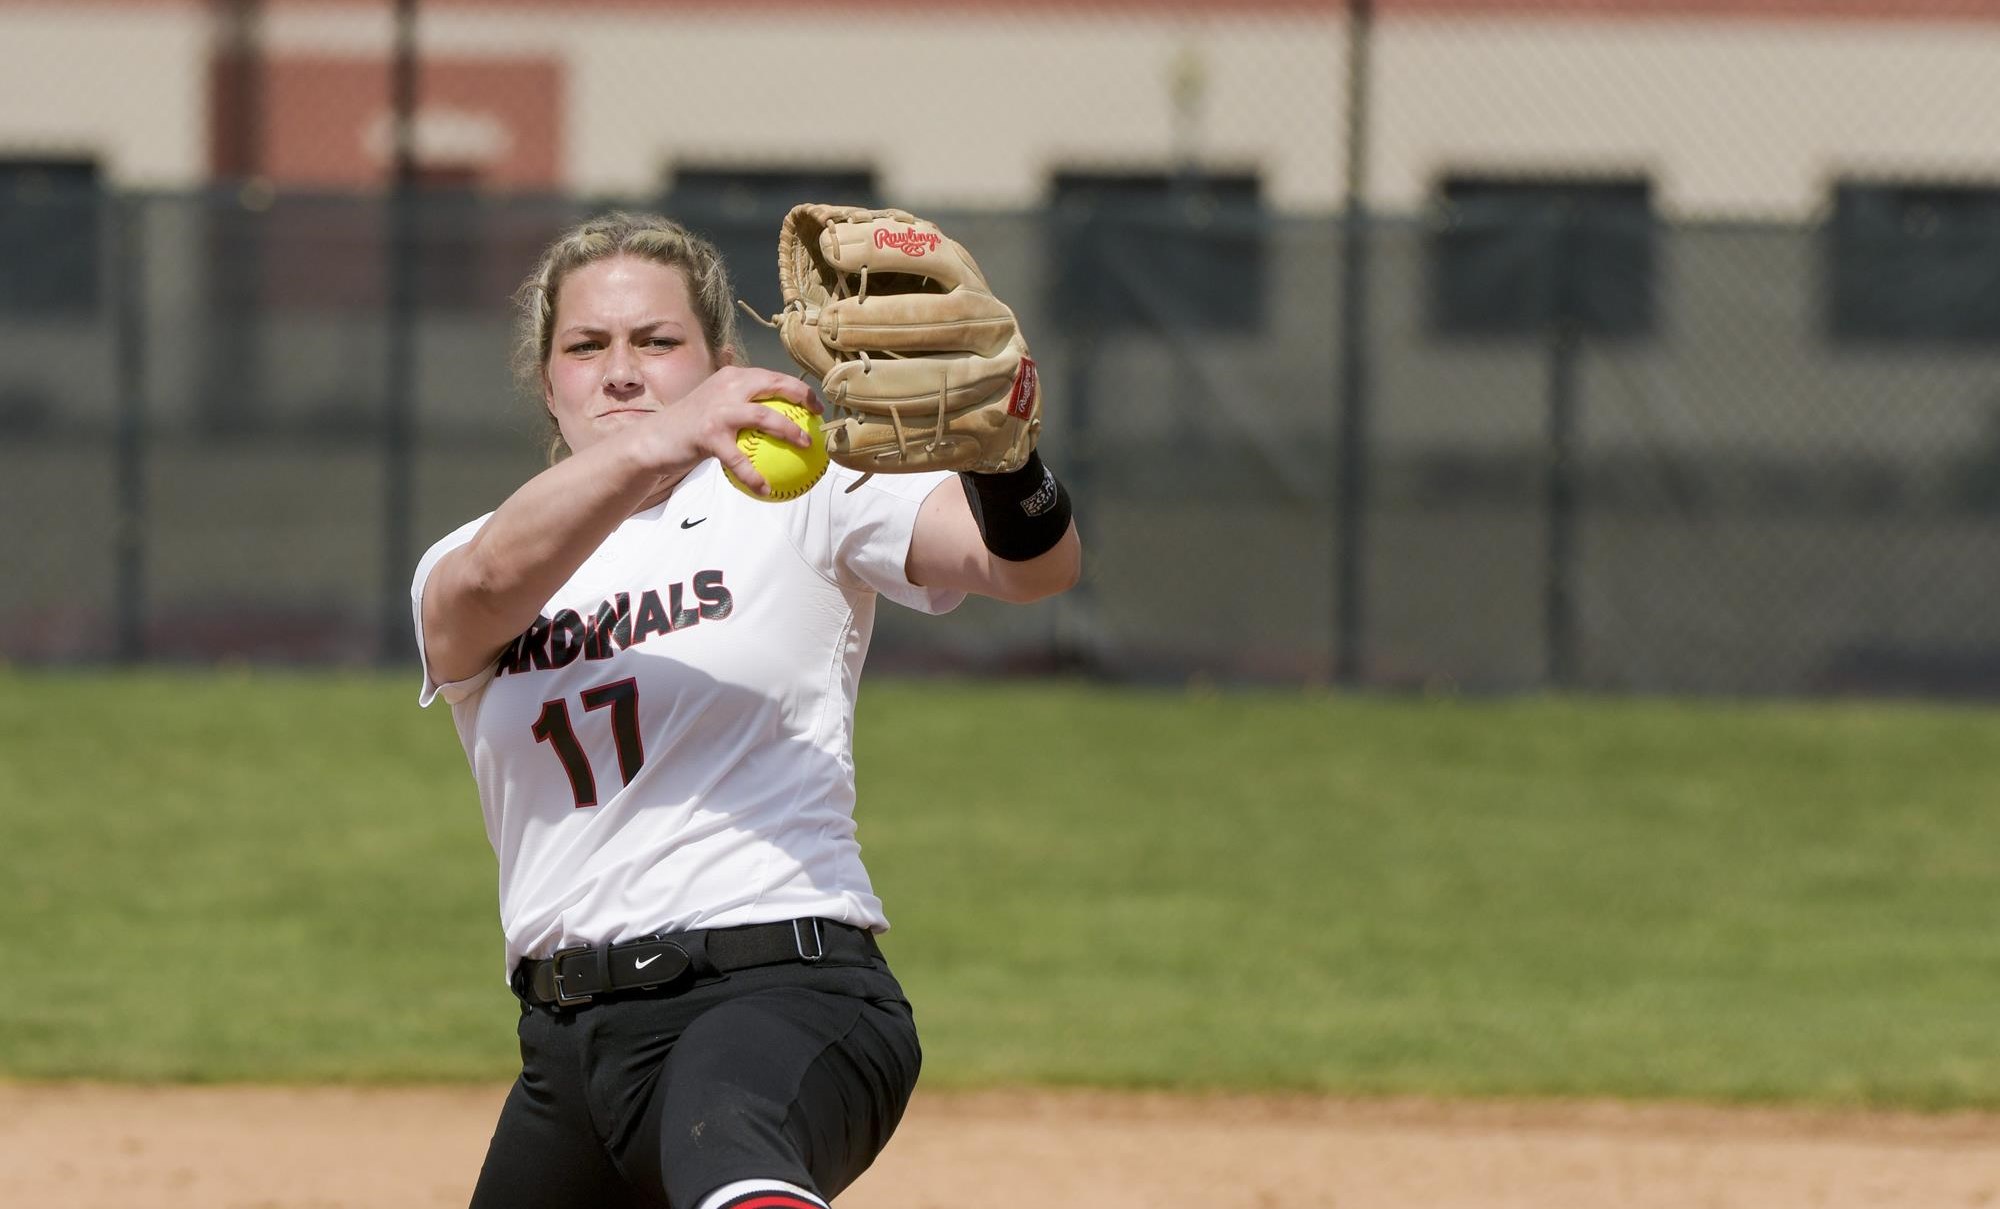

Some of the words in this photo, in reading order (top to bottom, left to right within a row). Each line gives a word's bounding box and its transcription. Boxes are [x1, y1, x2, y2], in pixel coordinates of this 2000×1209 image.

[874, 227, 941, 256] Rawlings
[495, 569, 734, 677] ARDINALS
[531, 676, 645, 809] 17
